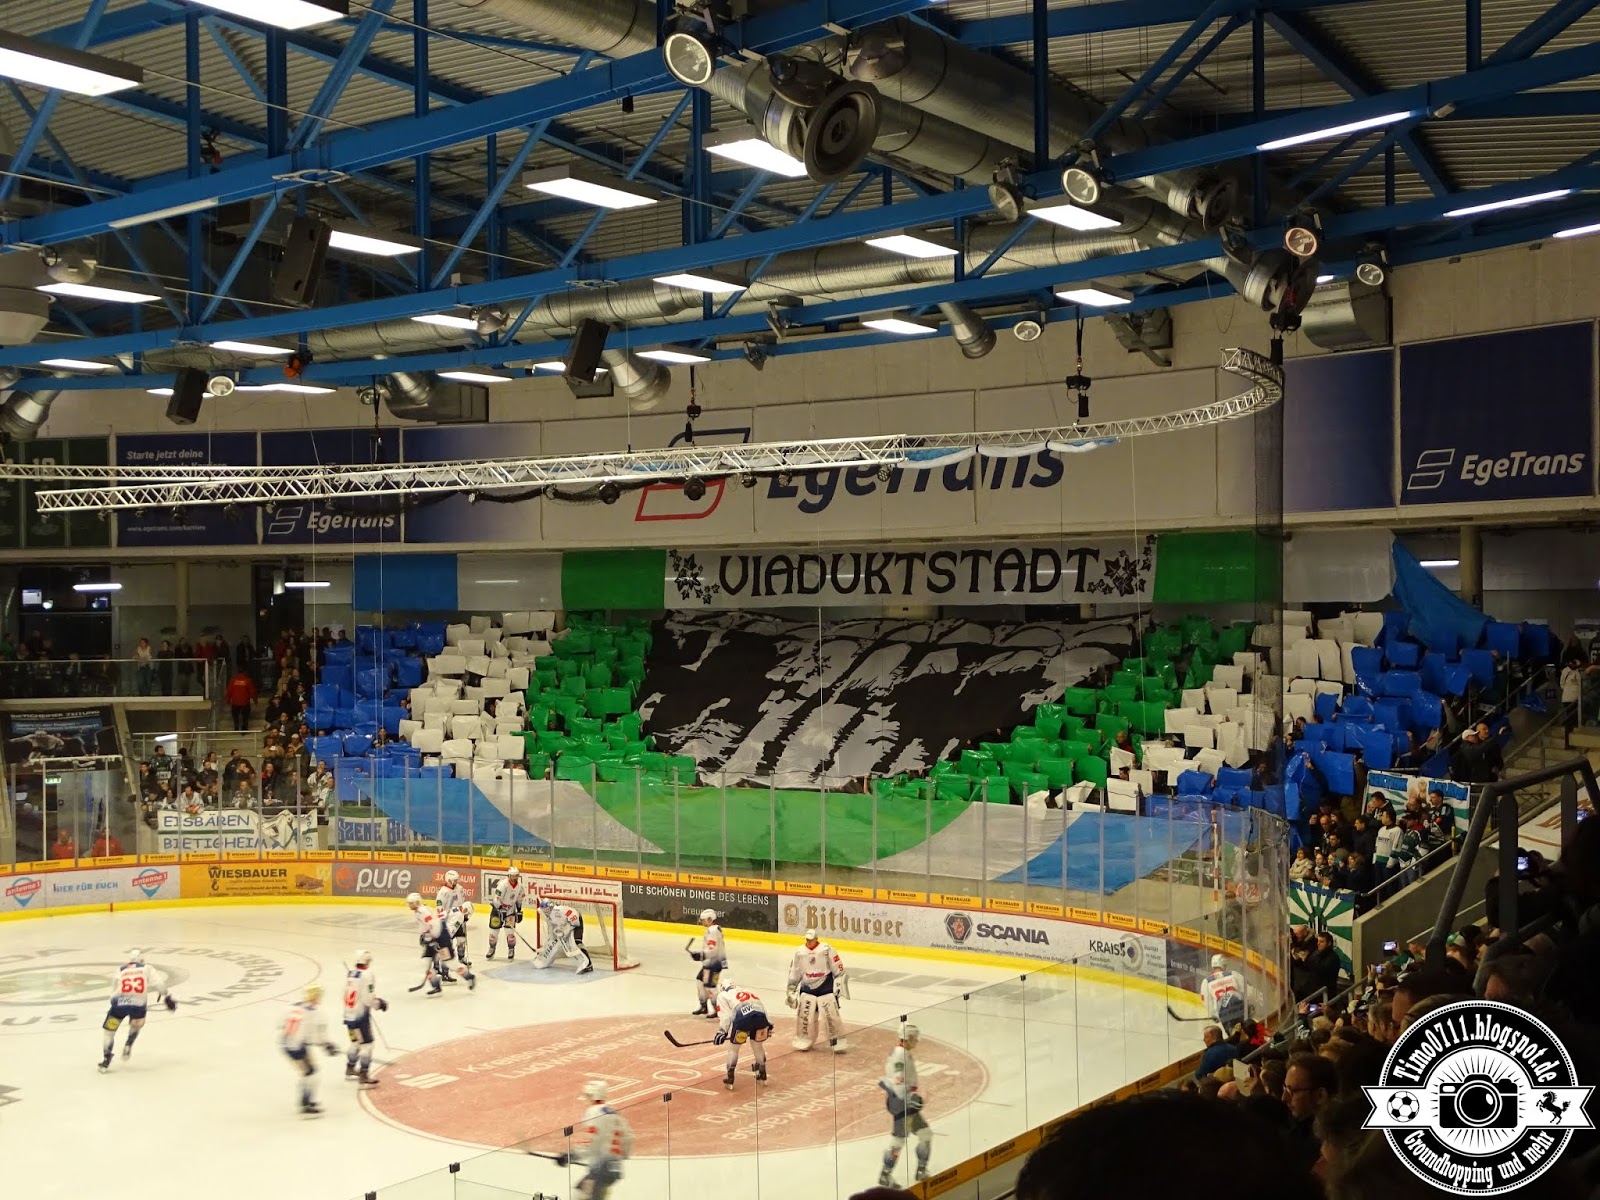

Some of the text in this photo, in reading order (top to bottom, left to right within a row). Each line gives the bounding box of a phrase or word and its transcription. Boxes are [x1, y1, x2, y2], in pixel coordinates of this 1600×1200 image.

[127, 449, 203, 461] Starte jetzt deine
[1460, 451, 1586, 486] EgeTrans
[718, 548, 1101, 597] VIADUKTSTADT
[164, 813, 250, 828] EISBÄREN
[163, 837, 268, 850] BIETIGHEIM
[208, 866, 287, 879] WIESBAUER
[435, 873, 476, 884] 3X AUM
[76, 883, 93, 892] FÜR
[95, 882, 118, 891] EUCH
[133, 875, 162, 887] antenne
[356, 868, 412, 892] pure
[7, 883, 35, 896] antenne
[630, 884, 769, 906] DIE SCHÖNEN DINGE DES LEBENS
[682, 905, 726, 918] breuer
[805, 905, 903, 938] Bitburger
[976, 923, 1050, 945] SCANIA
[121, 976, 144, 994] 63
